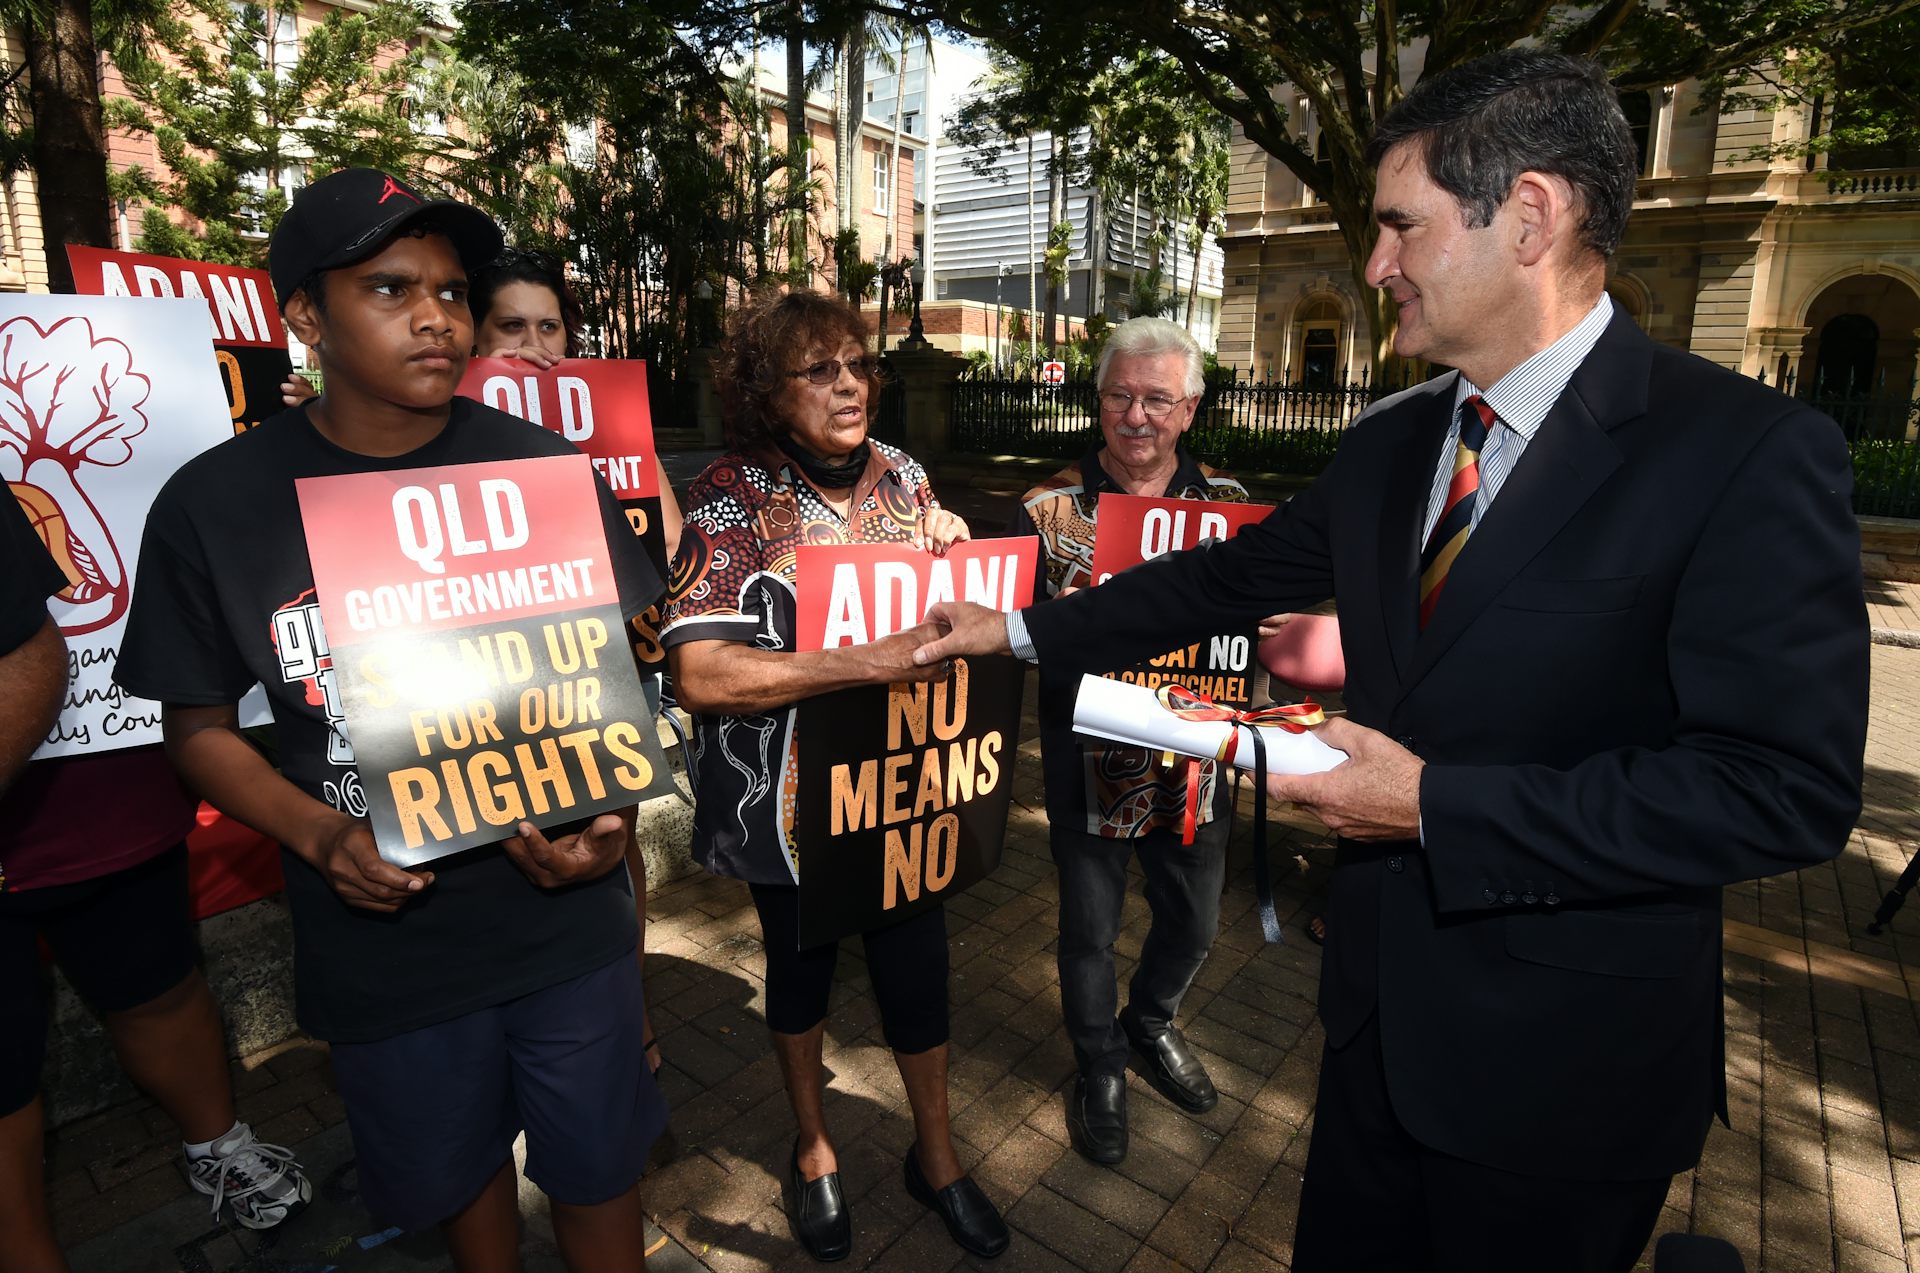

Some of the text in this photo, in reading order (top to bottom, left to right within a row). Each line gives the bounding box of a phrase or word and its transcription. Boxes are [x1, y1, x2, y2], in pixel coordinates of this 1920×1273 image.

[391, 477, 530, 574] QLD
[344, 558, 595, 633] GOVERNMENT
[822, 554, 1019, 650] ADANI
[359, 630, 535, 709] SND
[543, 617, 609, 675] UP
[1209, 634, 1249, 672] NO
[408, 698, 505, 757] FOR
[519, 676, 603, 736] OUR
[887, 657, 970, 750] NO
[387, 721, 654, 850] RIGHTS
[830, 730, 1003, 837] MEANS
[883, 812, 960, 911] NO
